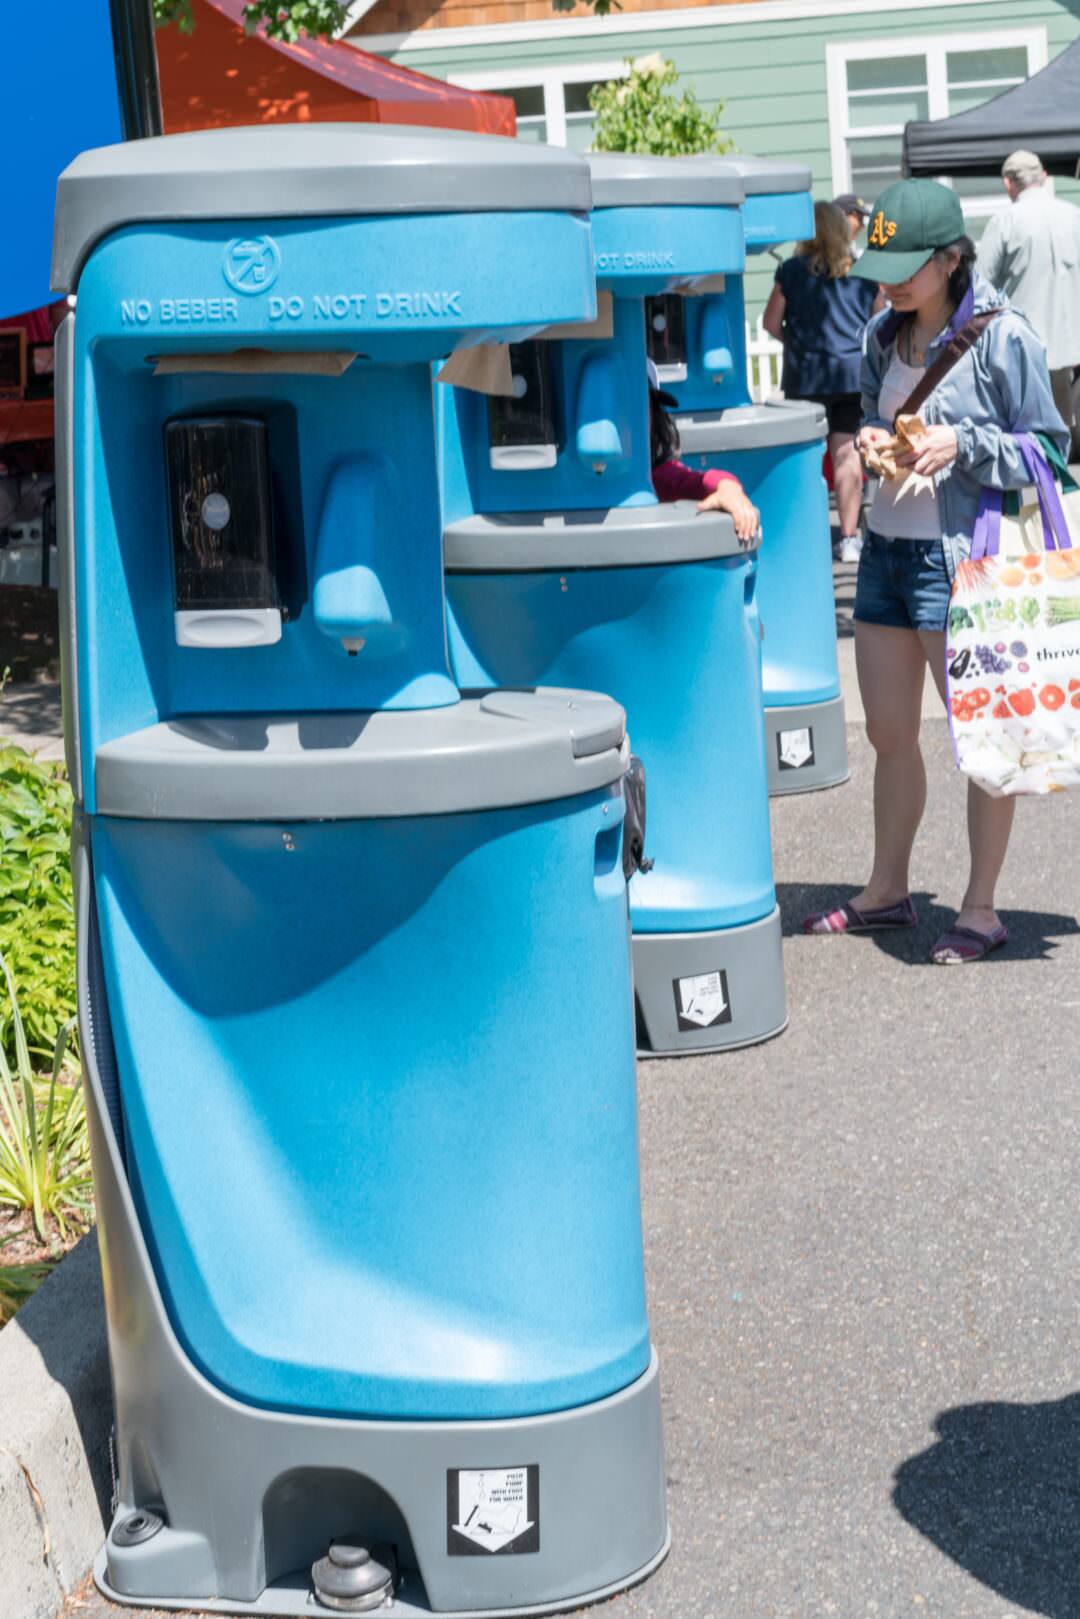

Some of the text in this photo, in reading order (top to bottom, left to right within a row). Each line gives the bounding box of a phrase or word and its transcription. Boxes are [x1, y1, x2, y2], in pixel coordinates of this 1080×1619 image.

[594, 250, 675, 270] OT DRINK
[120, 298, 240, 325] NO BEBER
[268, 290, 463, 321] DO NOT DRINK
